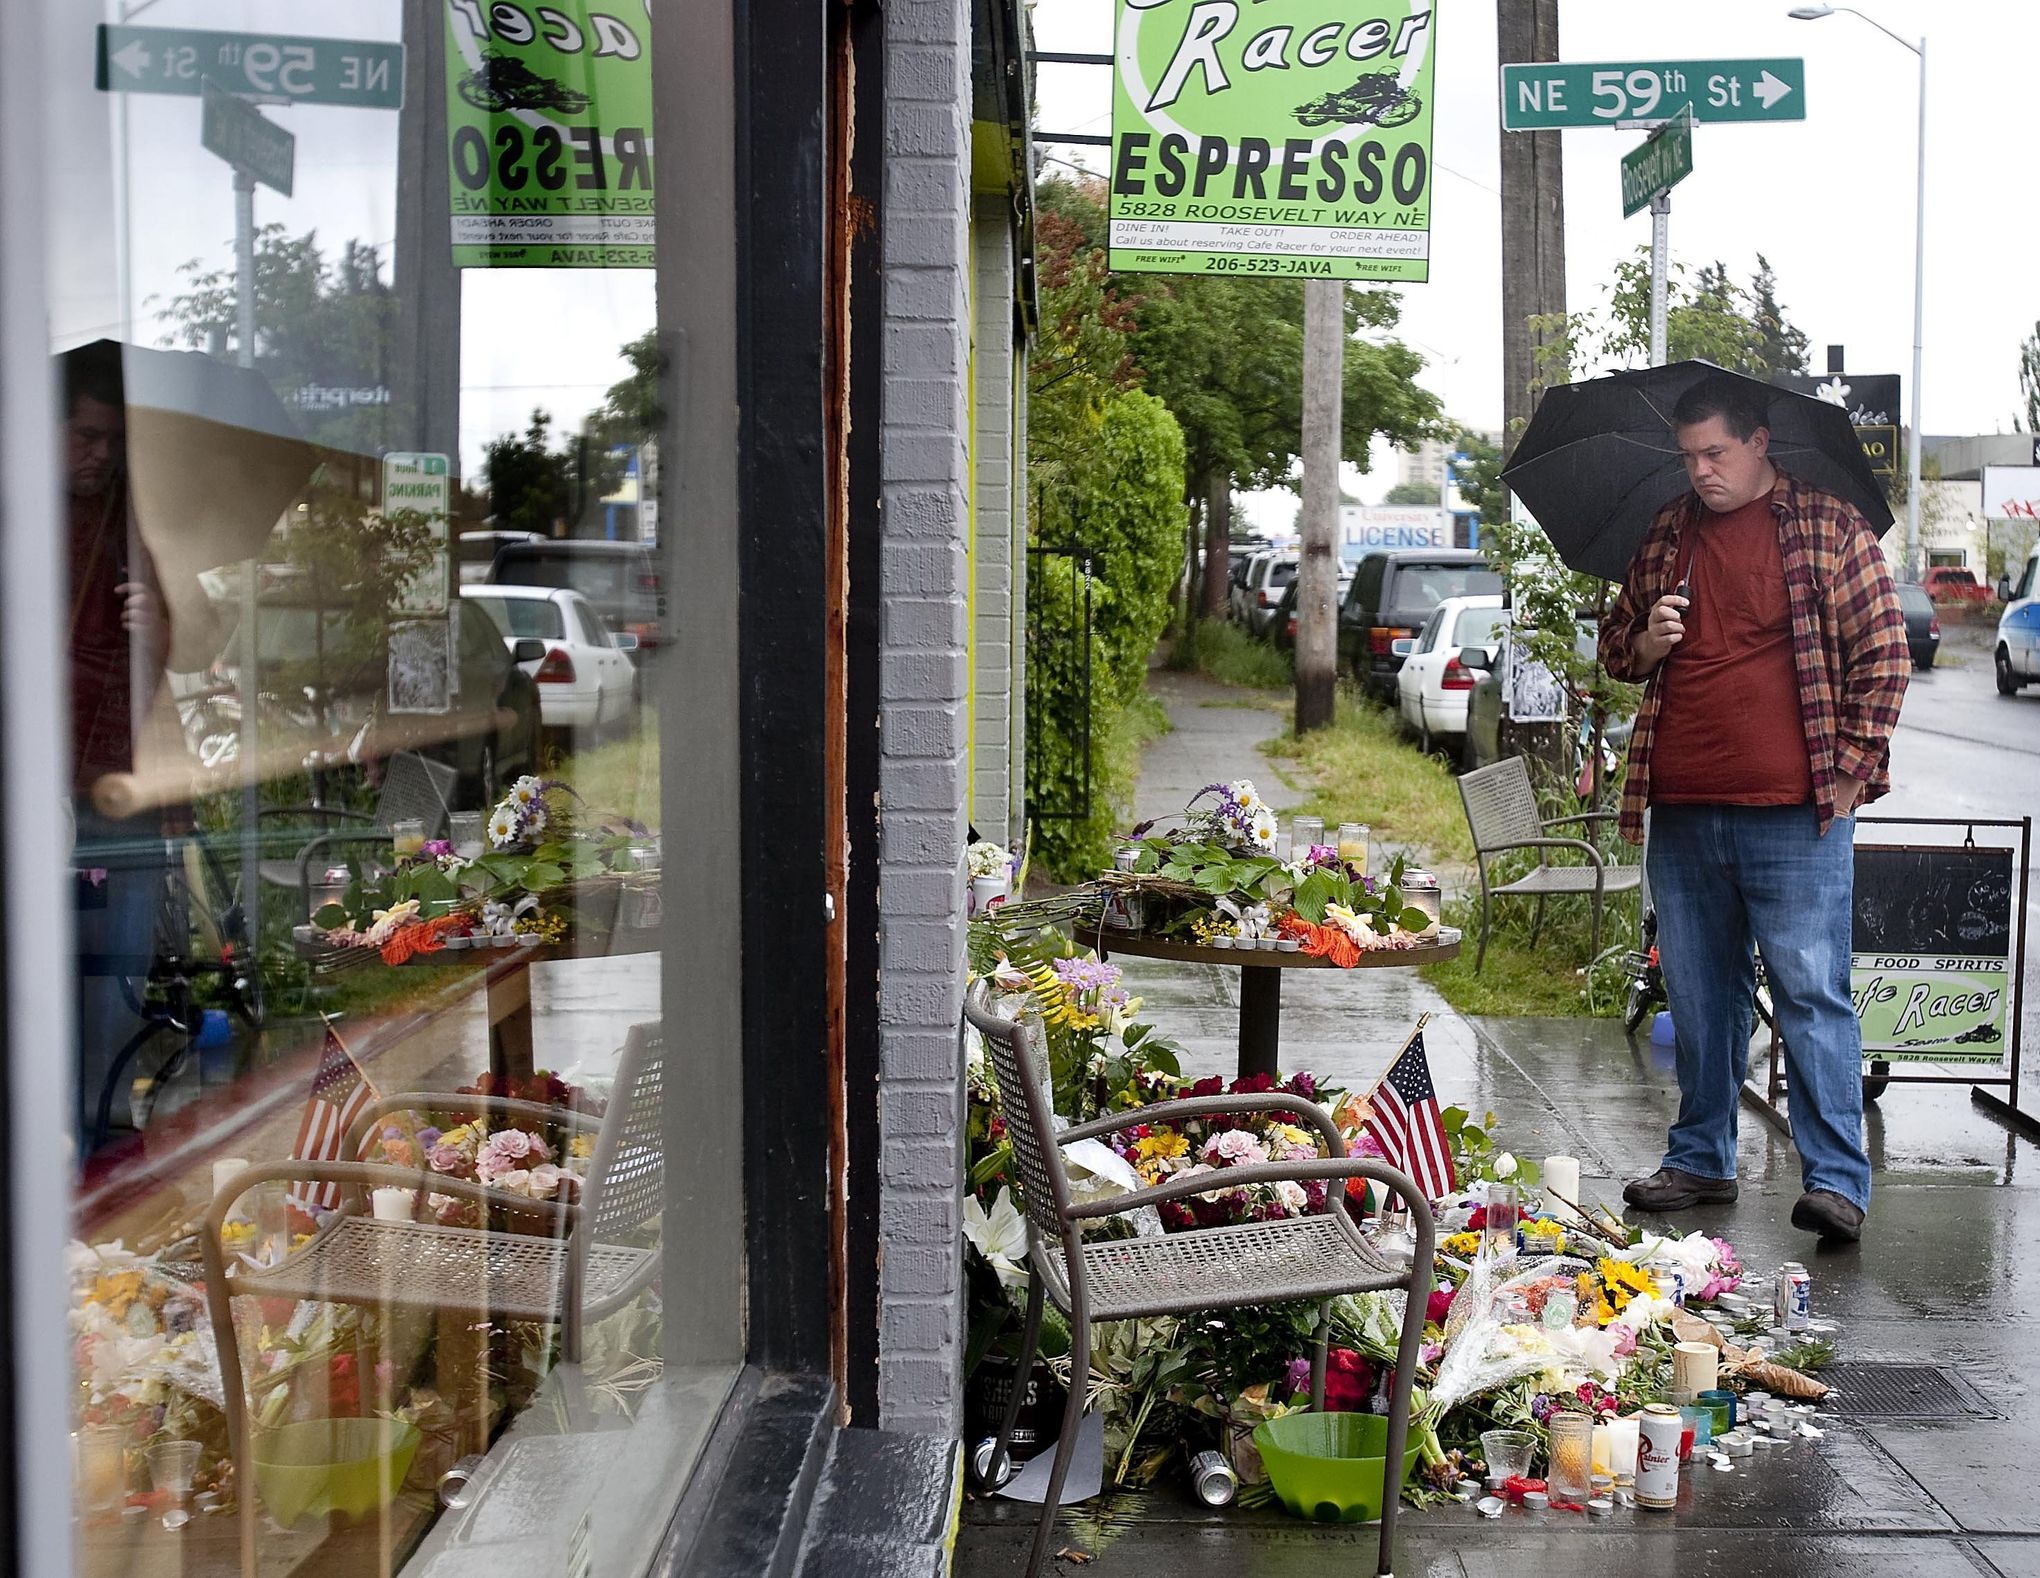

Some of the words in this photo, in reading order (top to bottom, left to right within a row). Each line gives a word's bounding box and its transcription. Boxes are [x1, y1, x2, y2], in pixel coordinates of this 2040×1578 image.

[1144, 0, 1432, 113] Racer
[1518, 79, 1568, 112] NE
[1591, 69, 1687, 118] 59th
[1707, 74, 1741, 107] St
[1113, 133, 1427, 205] ESPRESSO
[1118, 202, 1176, 217] 5828
[1185, 205, 1326, 222] ROOSEVELT
[1334, 210, 1386, 224] WAY
[1393, 213, 1425, 226] NE
[1115, 223, 1148, 233] DINE
[1150, 224, 1170, 233] IN!
[1219, 227, 1251, 236] TAKE
[1254, 228, 1284, 237] OUT!
[1330, 231, 1372, 241] ORDER
[1376, 233, 1422, 242] AHEAD!
[1115, 236, 1137, 244] Call
[1140, 238, 1153, 246] us
[1156, 237, 1189, 247] about
[1191, 239, 1243, 250] reserving
[1247, 240, 1272, 250] Cafe
[1275, 242, 1307, 251] Racer
[1310, 242, 1325, 251] for
[1329, 245, 1354, 253] your
[1357, 245, 1382, 254] next
[1386, 247, 1421, 255] event!
[1135, 255, 1156, 263] FREE
[1159, 256, 1181, 264] WIFI
[1205, 257, 1332, 274] 206-523-JAVA
[1346, 526, 1445, 547] LICENSE
[1874, 958, 1920, 969] FOOD
[1934, 959, 2004, 971] SPIRITS
[1892, 983, 2000, 1036] Racer
[1922, 1055, 1965, 1063] Roosevelt
[1968, 1056, 1987, 1064] Way
